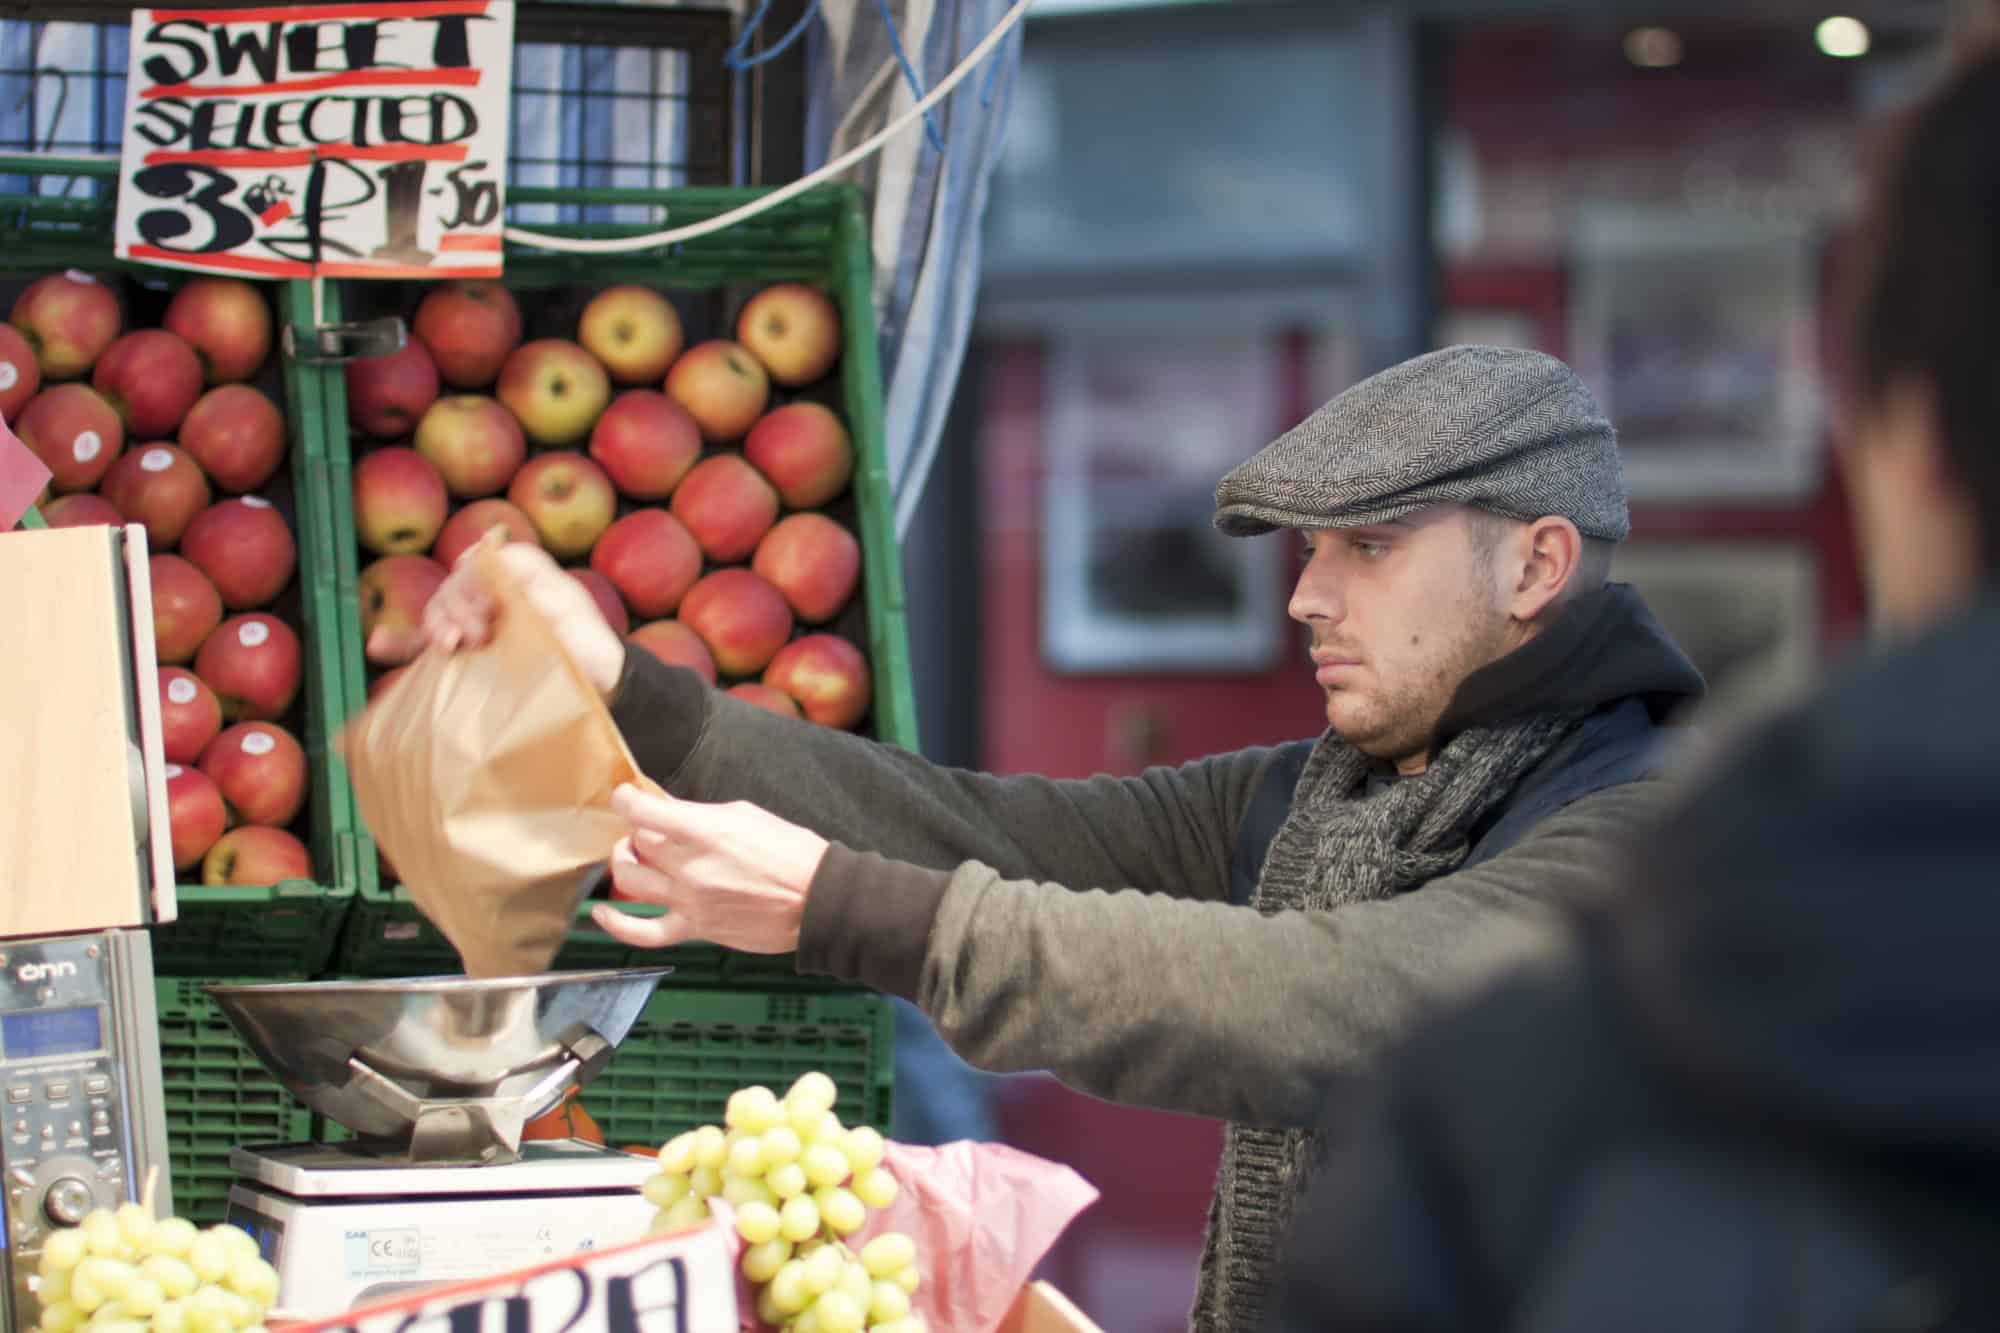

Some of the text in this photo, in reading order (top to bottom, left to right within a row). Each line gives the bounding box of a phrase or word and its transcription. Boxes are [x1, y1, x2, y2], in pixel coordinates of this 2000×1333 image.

[142, 14, 495, 85] SWEET
[133, 92, 479, 150] SELECTED
[132, 163, 254, 254] 3
